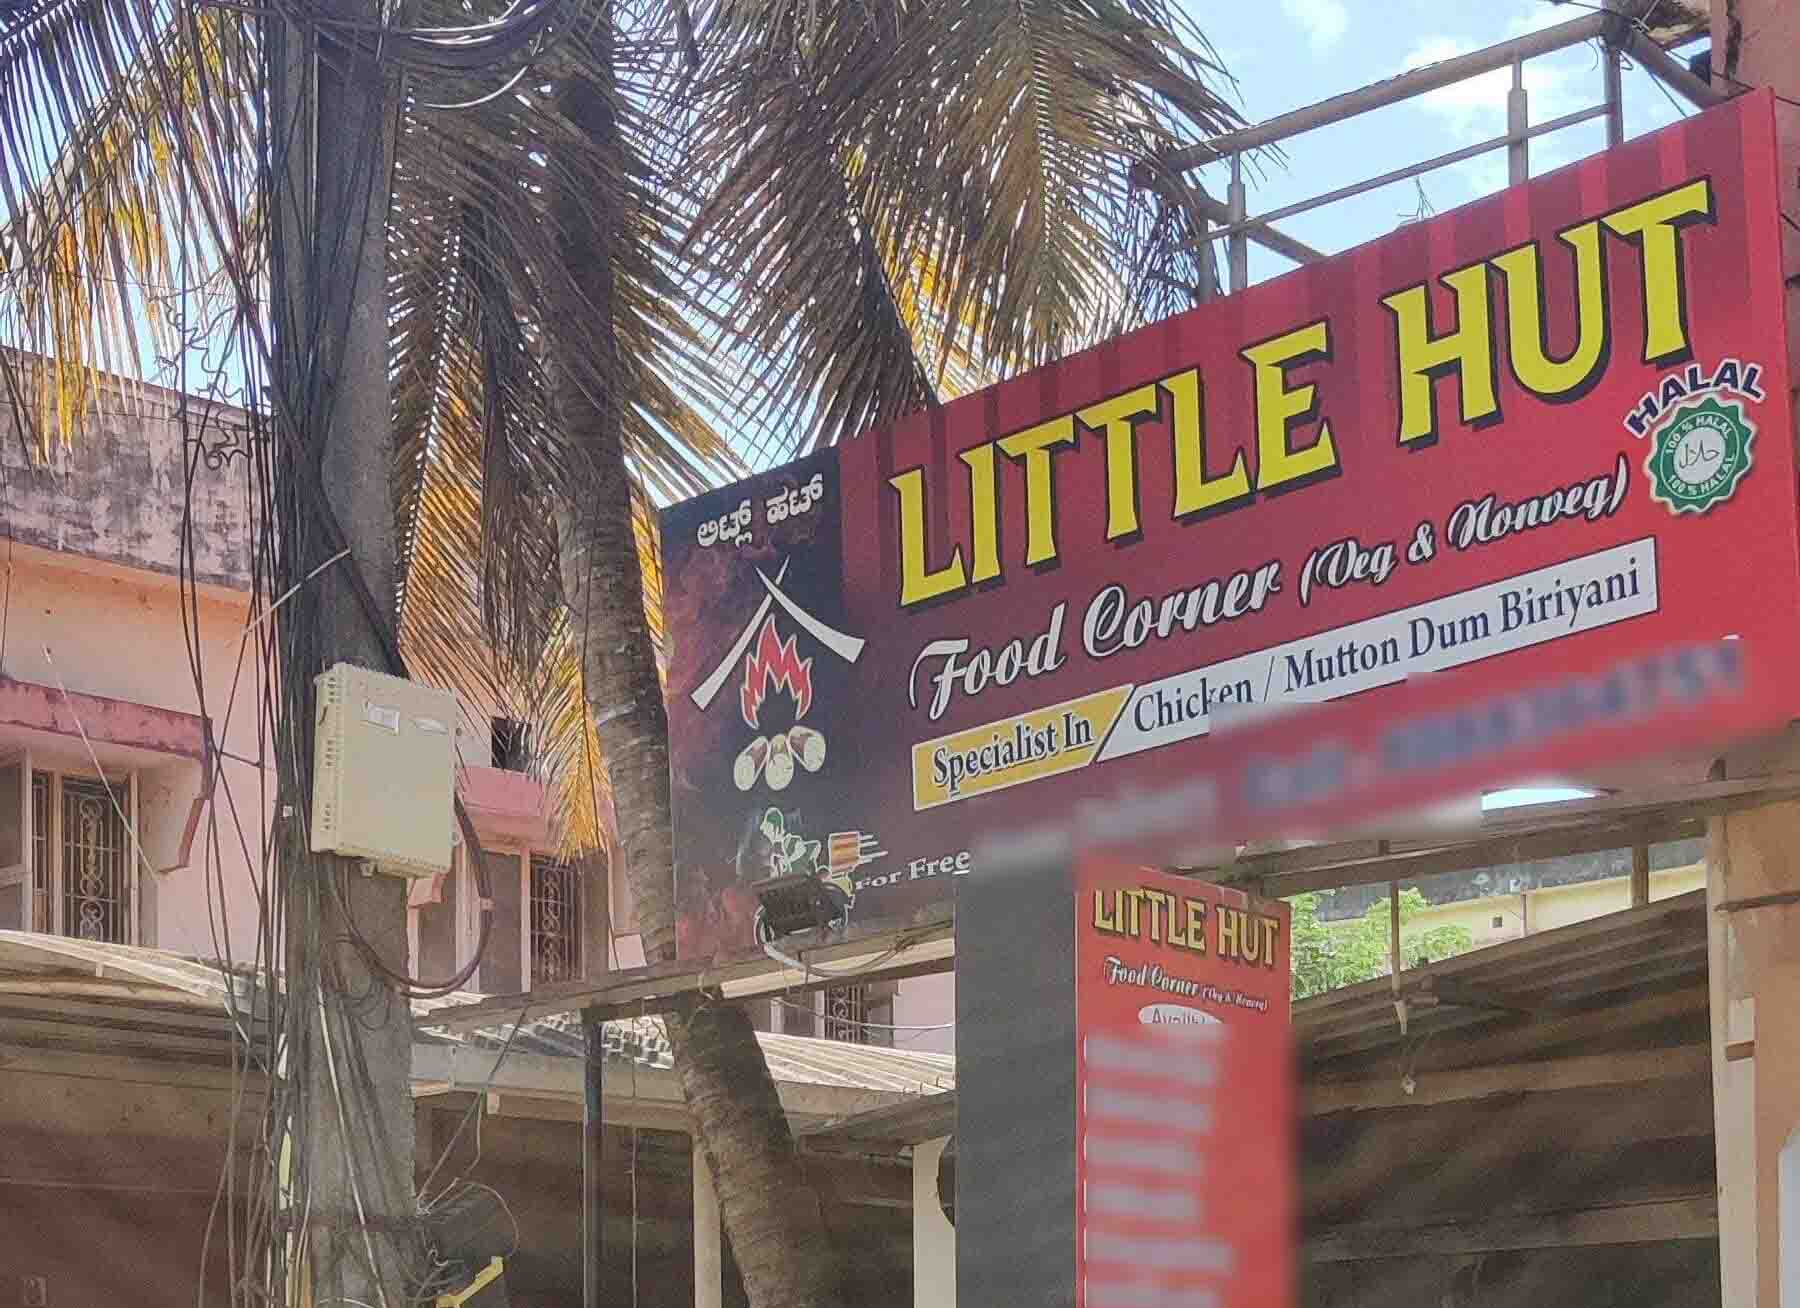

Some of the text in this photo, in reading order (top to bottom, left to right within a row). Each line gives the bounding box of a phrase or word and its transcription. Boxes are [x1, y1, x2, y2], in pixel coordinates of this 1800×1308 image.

[888, 180, 1712, 606] LITTLE HUT
[1624, 359, 1766, 438] HALAL
[909, 454, 1629, 720] Food Corner (Veg & Nonveg)
[1134, 677, 1253, 733] Chicken
[1283, 634, 1400, 694] Mutton
[1407, 599, 1491, 659] Dum
[1498, 557, 1641, 628] Biriyani
[933, 710, 1096, 795] Specialist In
[908, 851, 971, 880] Free
[1094, 888, 1279, 965] LITTLE HUT
[1105, 956, 1147, 985] Food
[1151, 966, 1200, 997] Corner
